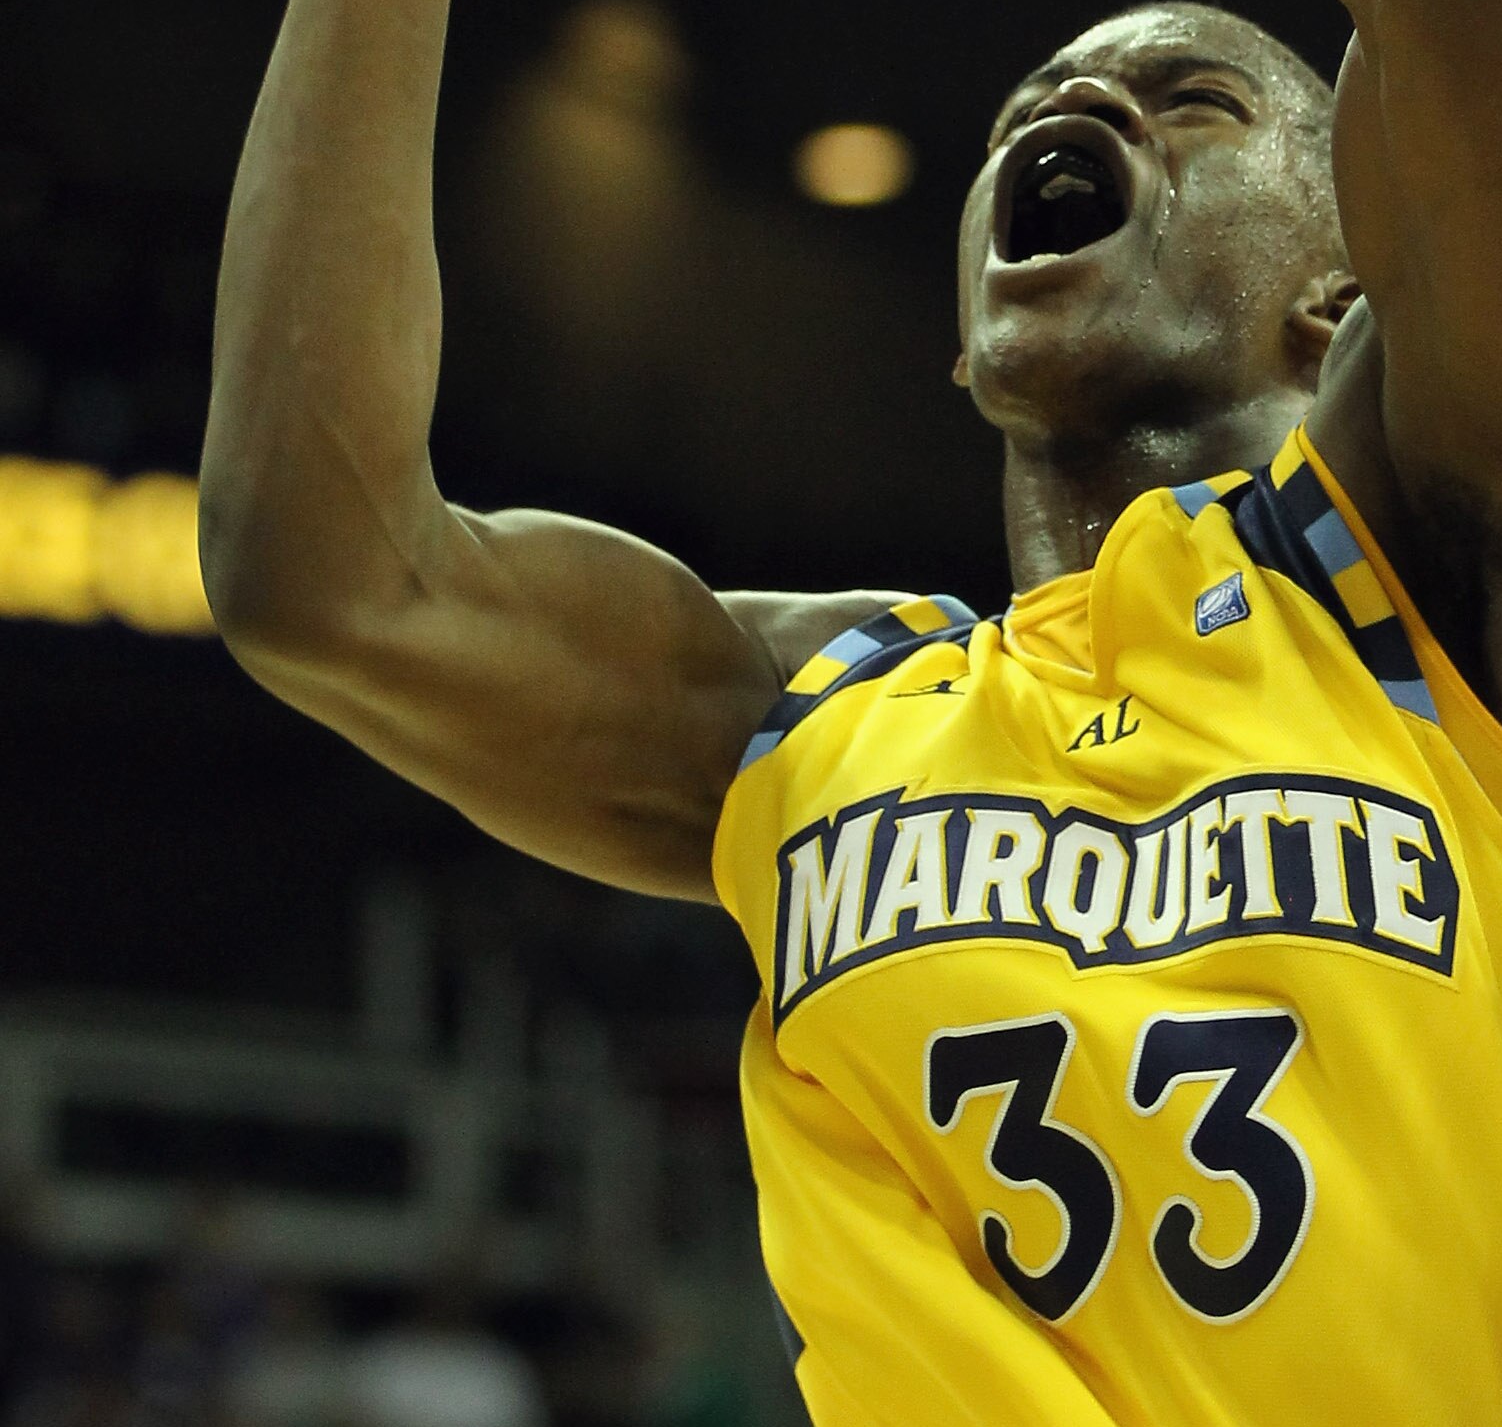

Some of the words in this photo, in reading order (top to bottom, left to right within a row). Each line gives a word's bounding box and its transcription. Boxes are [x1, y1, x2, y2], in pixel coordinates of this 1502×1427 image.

[1065, 693, 1141, 753] AL
[780, 788, 1448, 1011] MARQUETTE
[925, 1009, 1317, 1326] 33
